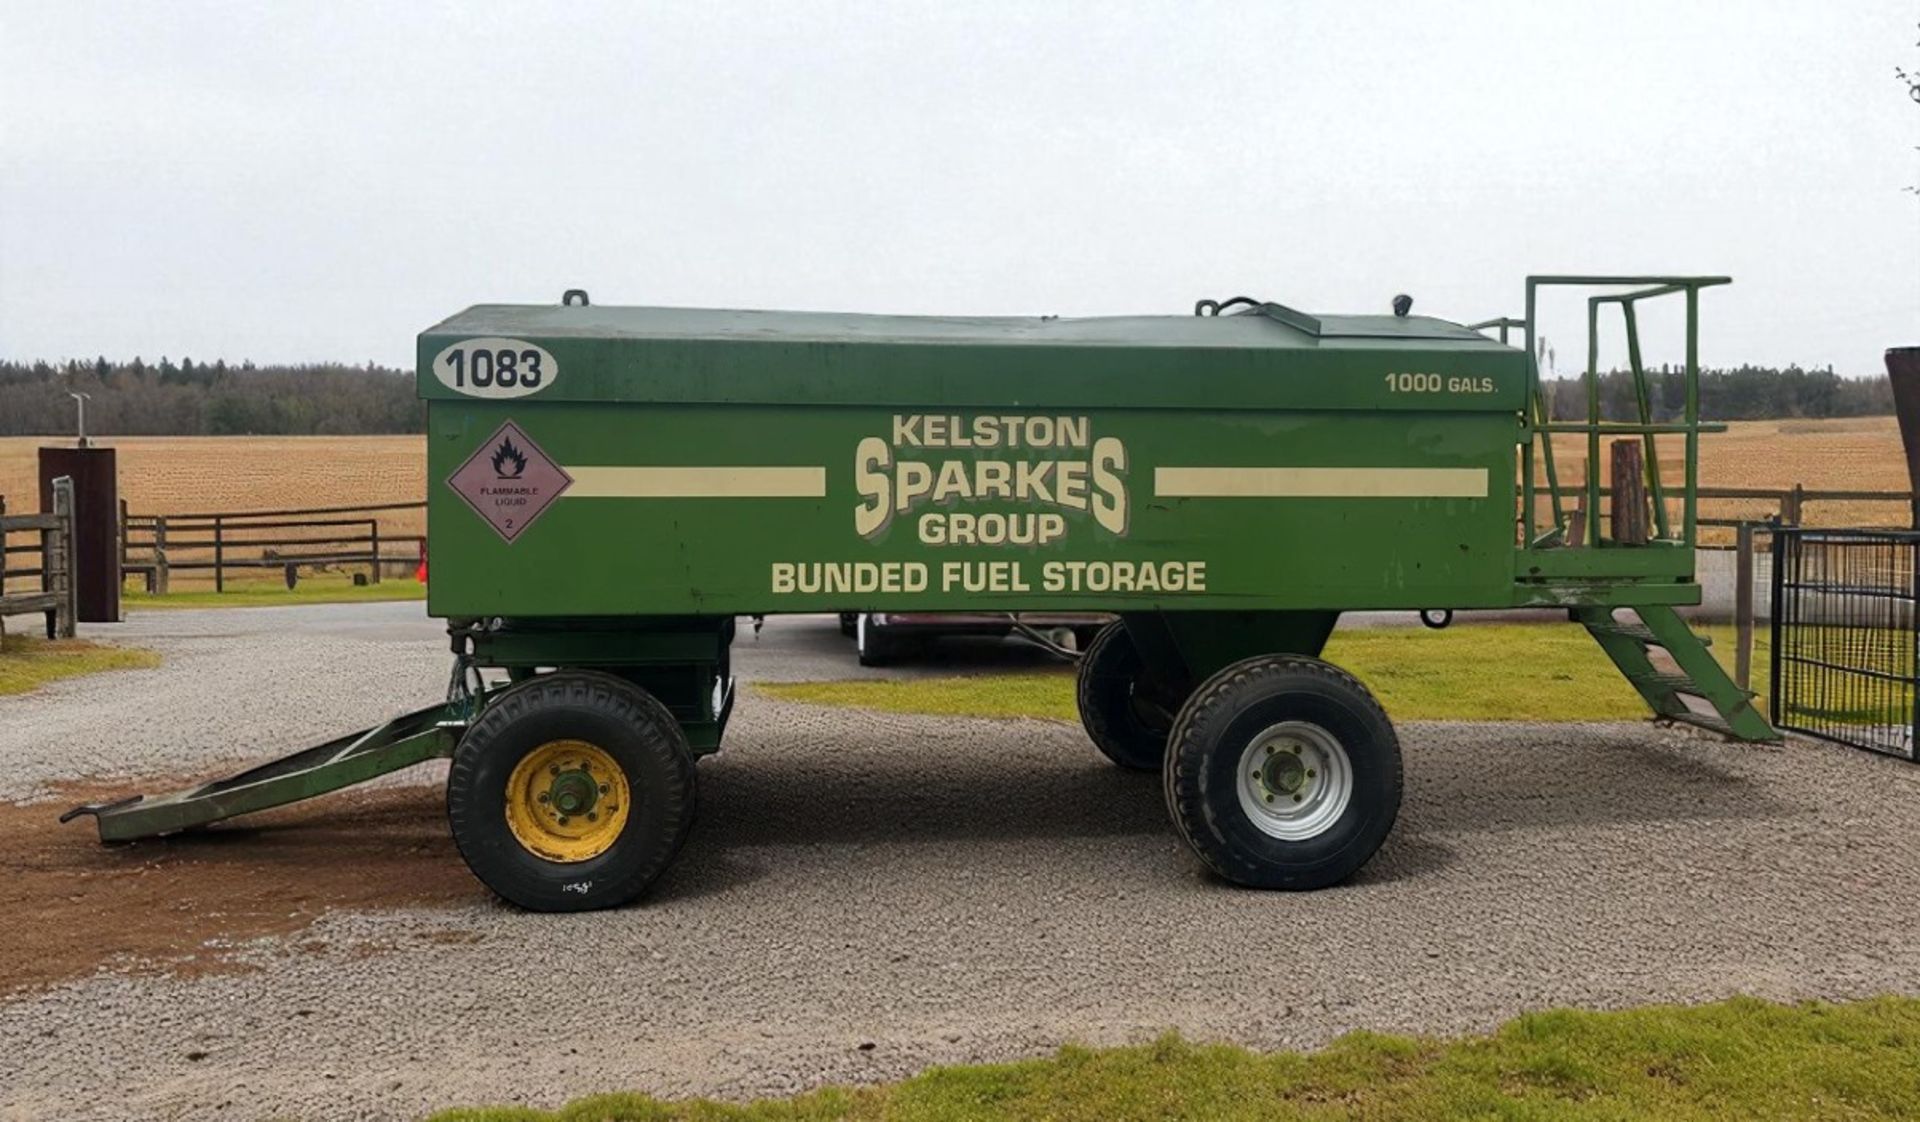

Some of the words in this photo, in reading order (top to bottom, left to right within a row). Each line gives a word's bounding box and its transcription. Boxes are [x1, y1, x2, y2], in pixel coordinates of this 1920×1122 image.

[445, 348, 543, 388] 1083
[1385, 373, 1442, 392] 1000
[1448, 377, 1499, 393] GALS.
[892, 415, 1089, 447] KELSTON
[480, 487, 539, 496] FLAMMABLE
[495, 498, 528, 506] LIQUID
[854, 436, 1128, 538] SPARKES
[917, 512, 1066, 545] GROUP
[771, 562, 929, 594] BUNDED
[942, 561, 1030, 592] FUEL
[1042, 561, 1207, 592] STORAGE
